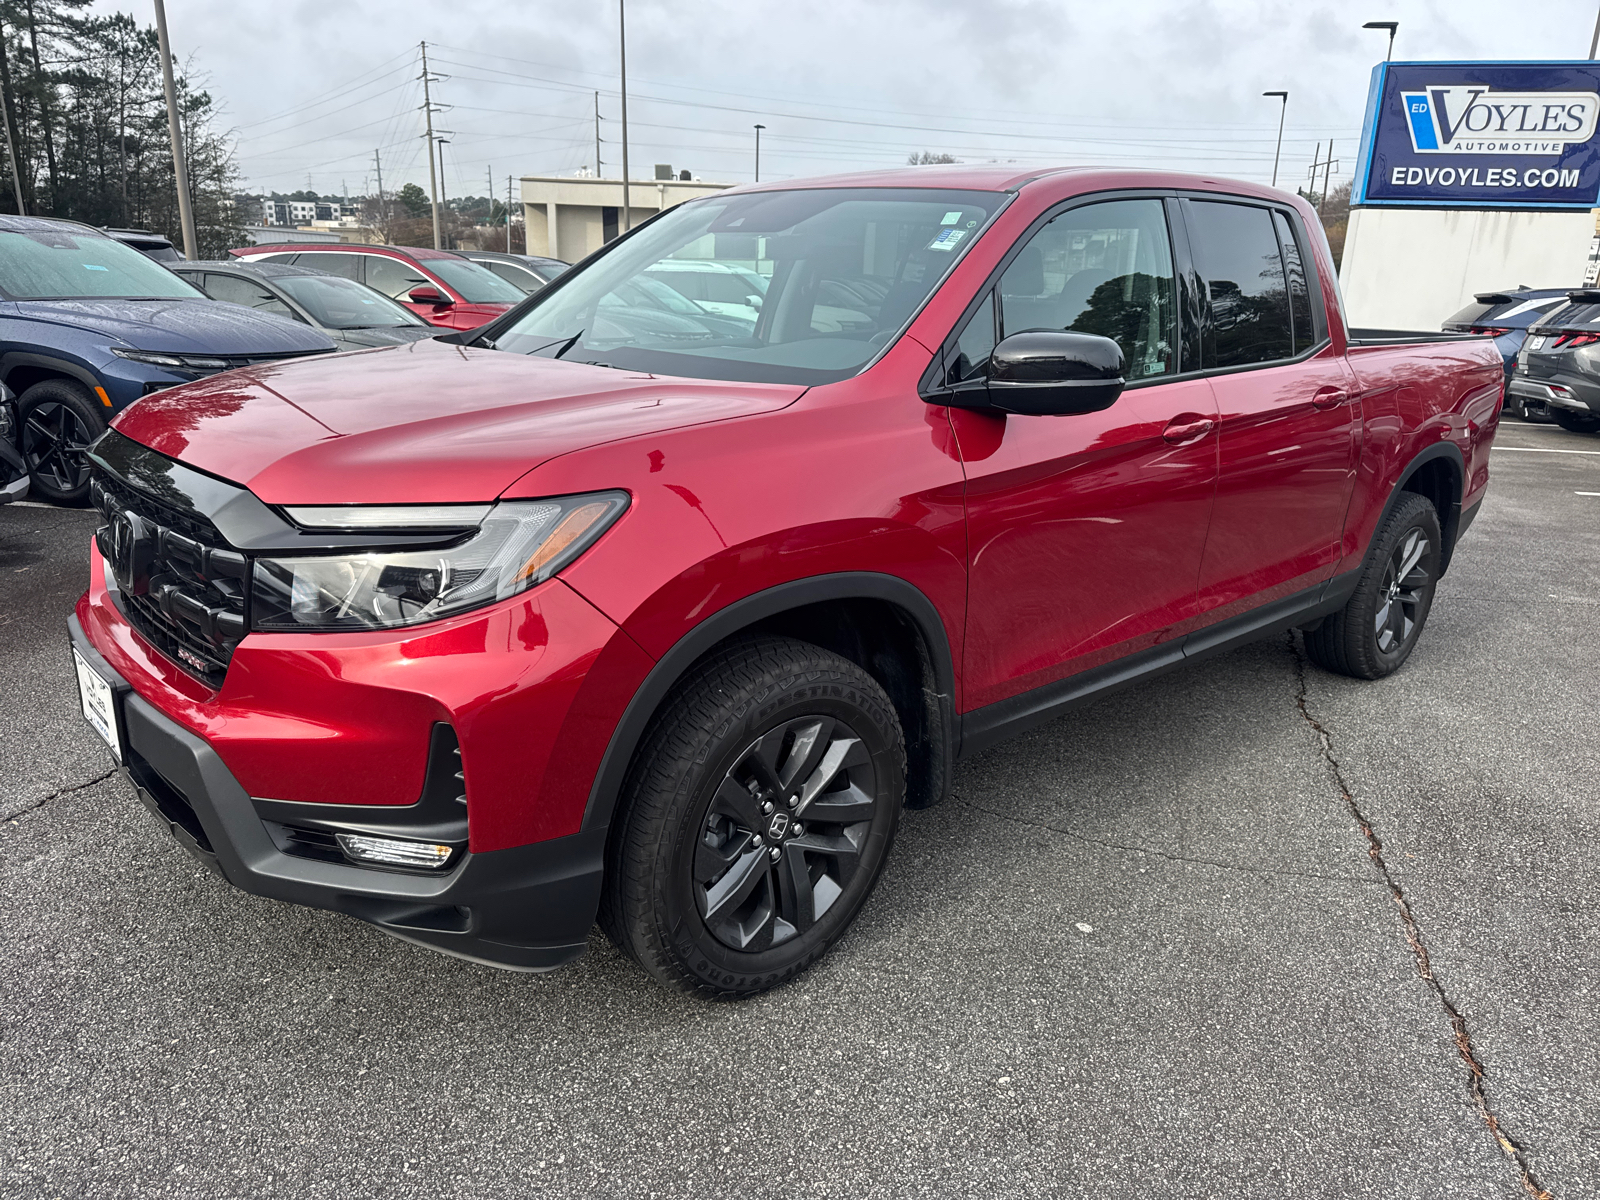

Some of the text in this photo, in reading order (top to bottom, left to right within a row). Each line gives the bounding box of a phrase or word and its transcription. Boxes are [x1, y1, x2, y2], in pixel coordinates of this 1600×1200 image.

[1411, 89, 1586, 145] ED VOYLES
[1453, 142, 1561, 152] AUTOMOTIVE
[1391, 167, 1580, 188] EDVOYLES.COM
[178, 648, 206, 671] SPORT
[758, 685, 889, 736] DESTINATION
